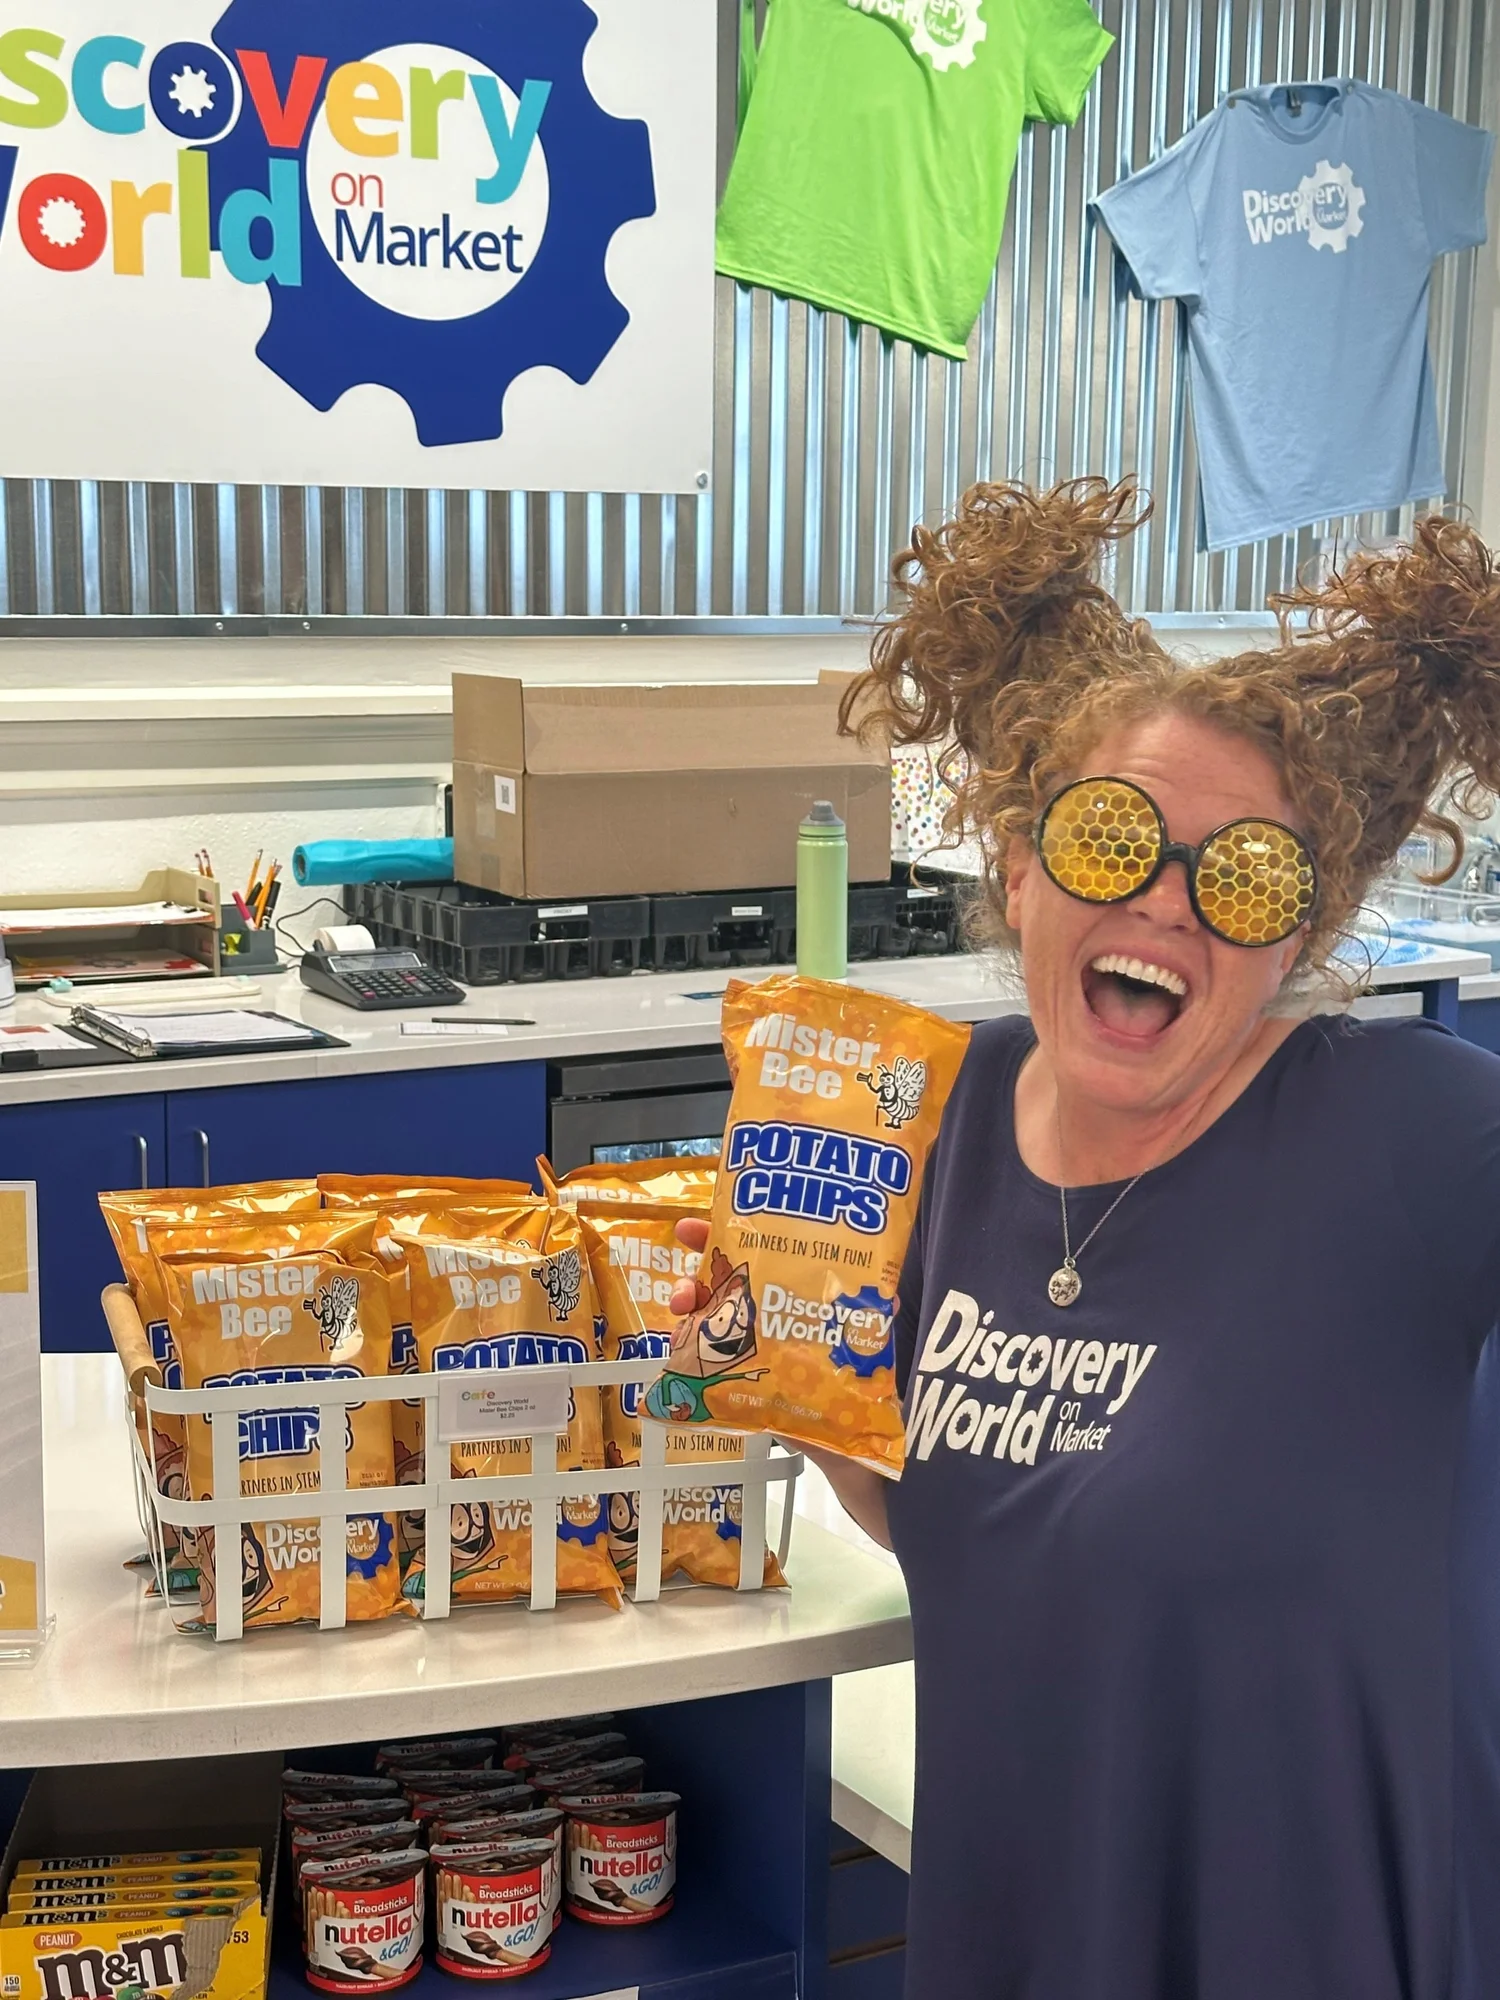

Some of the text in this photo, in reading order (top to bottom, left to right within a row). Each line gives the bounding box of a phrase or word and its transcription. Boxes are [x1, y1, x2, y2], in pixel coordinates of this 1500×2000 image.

[331, 172, 383, 208] on
[1246, 209, 1311, 245] World
[335, 209, 523, 274] Market
[743, 1013, 881, 1069] Mister
[759, 1050, 842, 1099] Bee
[728, 1122, 912, 1194] POTATO
[733, 1168, 888, 1233] CHIPS
[609, 1235, 705, 1276] Miste
[738, 1232, 873, 1268] PARTNERS IN STEM FUN!
[192, 1263, 319, 1304] Mister
[450, 1275, 521, 1310] Bee
[629, 1270, 680, 1308] Be
[219, 1304, 292, 1340] Bee
[761, 1283, 893, 1337] Discovery
[761, 1311, 845, 1347] World
[846, 1334, 885, 1350] Market
[918, 1289, 1158, 1415] Discovery
[486, 1399, 512, 1407] Discovery
[728, 1392, 748, 1404] NET
[1059, 1400, 1081, 1422] on
[905, 1375, 1055, 1466] World
[238, 1412, 353, 1464] CHIP
[460, 1439, 506, 1458] PARTNERS
[509, 1439, 523, 1453] IN
[674, 1436, 687, 1450] IN
[690, 1434, 714, 1451] STEM
[718, 1435, 742, 1453] FUN!
[1050, 1420, 1112, 1453] Market
[280, 1476, 293, 1491] IN
[296, 1471, 321, 1490] STEM
[565, 1510, 598, 1521] Market
[267, 1545, 321, 1571] Wor
[347, 1541, 377, 1554] Market
[475, 1581, 491, 1589] NET
[581, 1794, 635, 1804] nutella
[316, 1829, 373, 1842] nutella
[452, 1843, 509, 1854] nutella
[606, 1834, 658, 1848] Breadsticks
[323, 1857, 381, 1872] nutella
[580, 1852, 663, 1877] nutella
[127, 1875, 159, 1883] PEANUT
[479, 1884, 533, 1899] Breadsticks
[630, 1868, 664, 1896] &GO!
[128, 1892, 159, 1900] PEANUT
[354, 1896, 408, 1914] Breadsticks
[119, 1910, 151, 1918] PEANUT
[452, 1902, 538, 1929] nutella
[40, 1933, 75, 1946] PEANUT
[116, 1925, 163, 1939] CHOCOLATE CANDIES
[325, 1914, 412, 1945] nutella
[504, 1916, 540, 1947] &GO!
[380, 1935, 413, 1961] &GO!
[5, 1976, 20, 1985] 150
